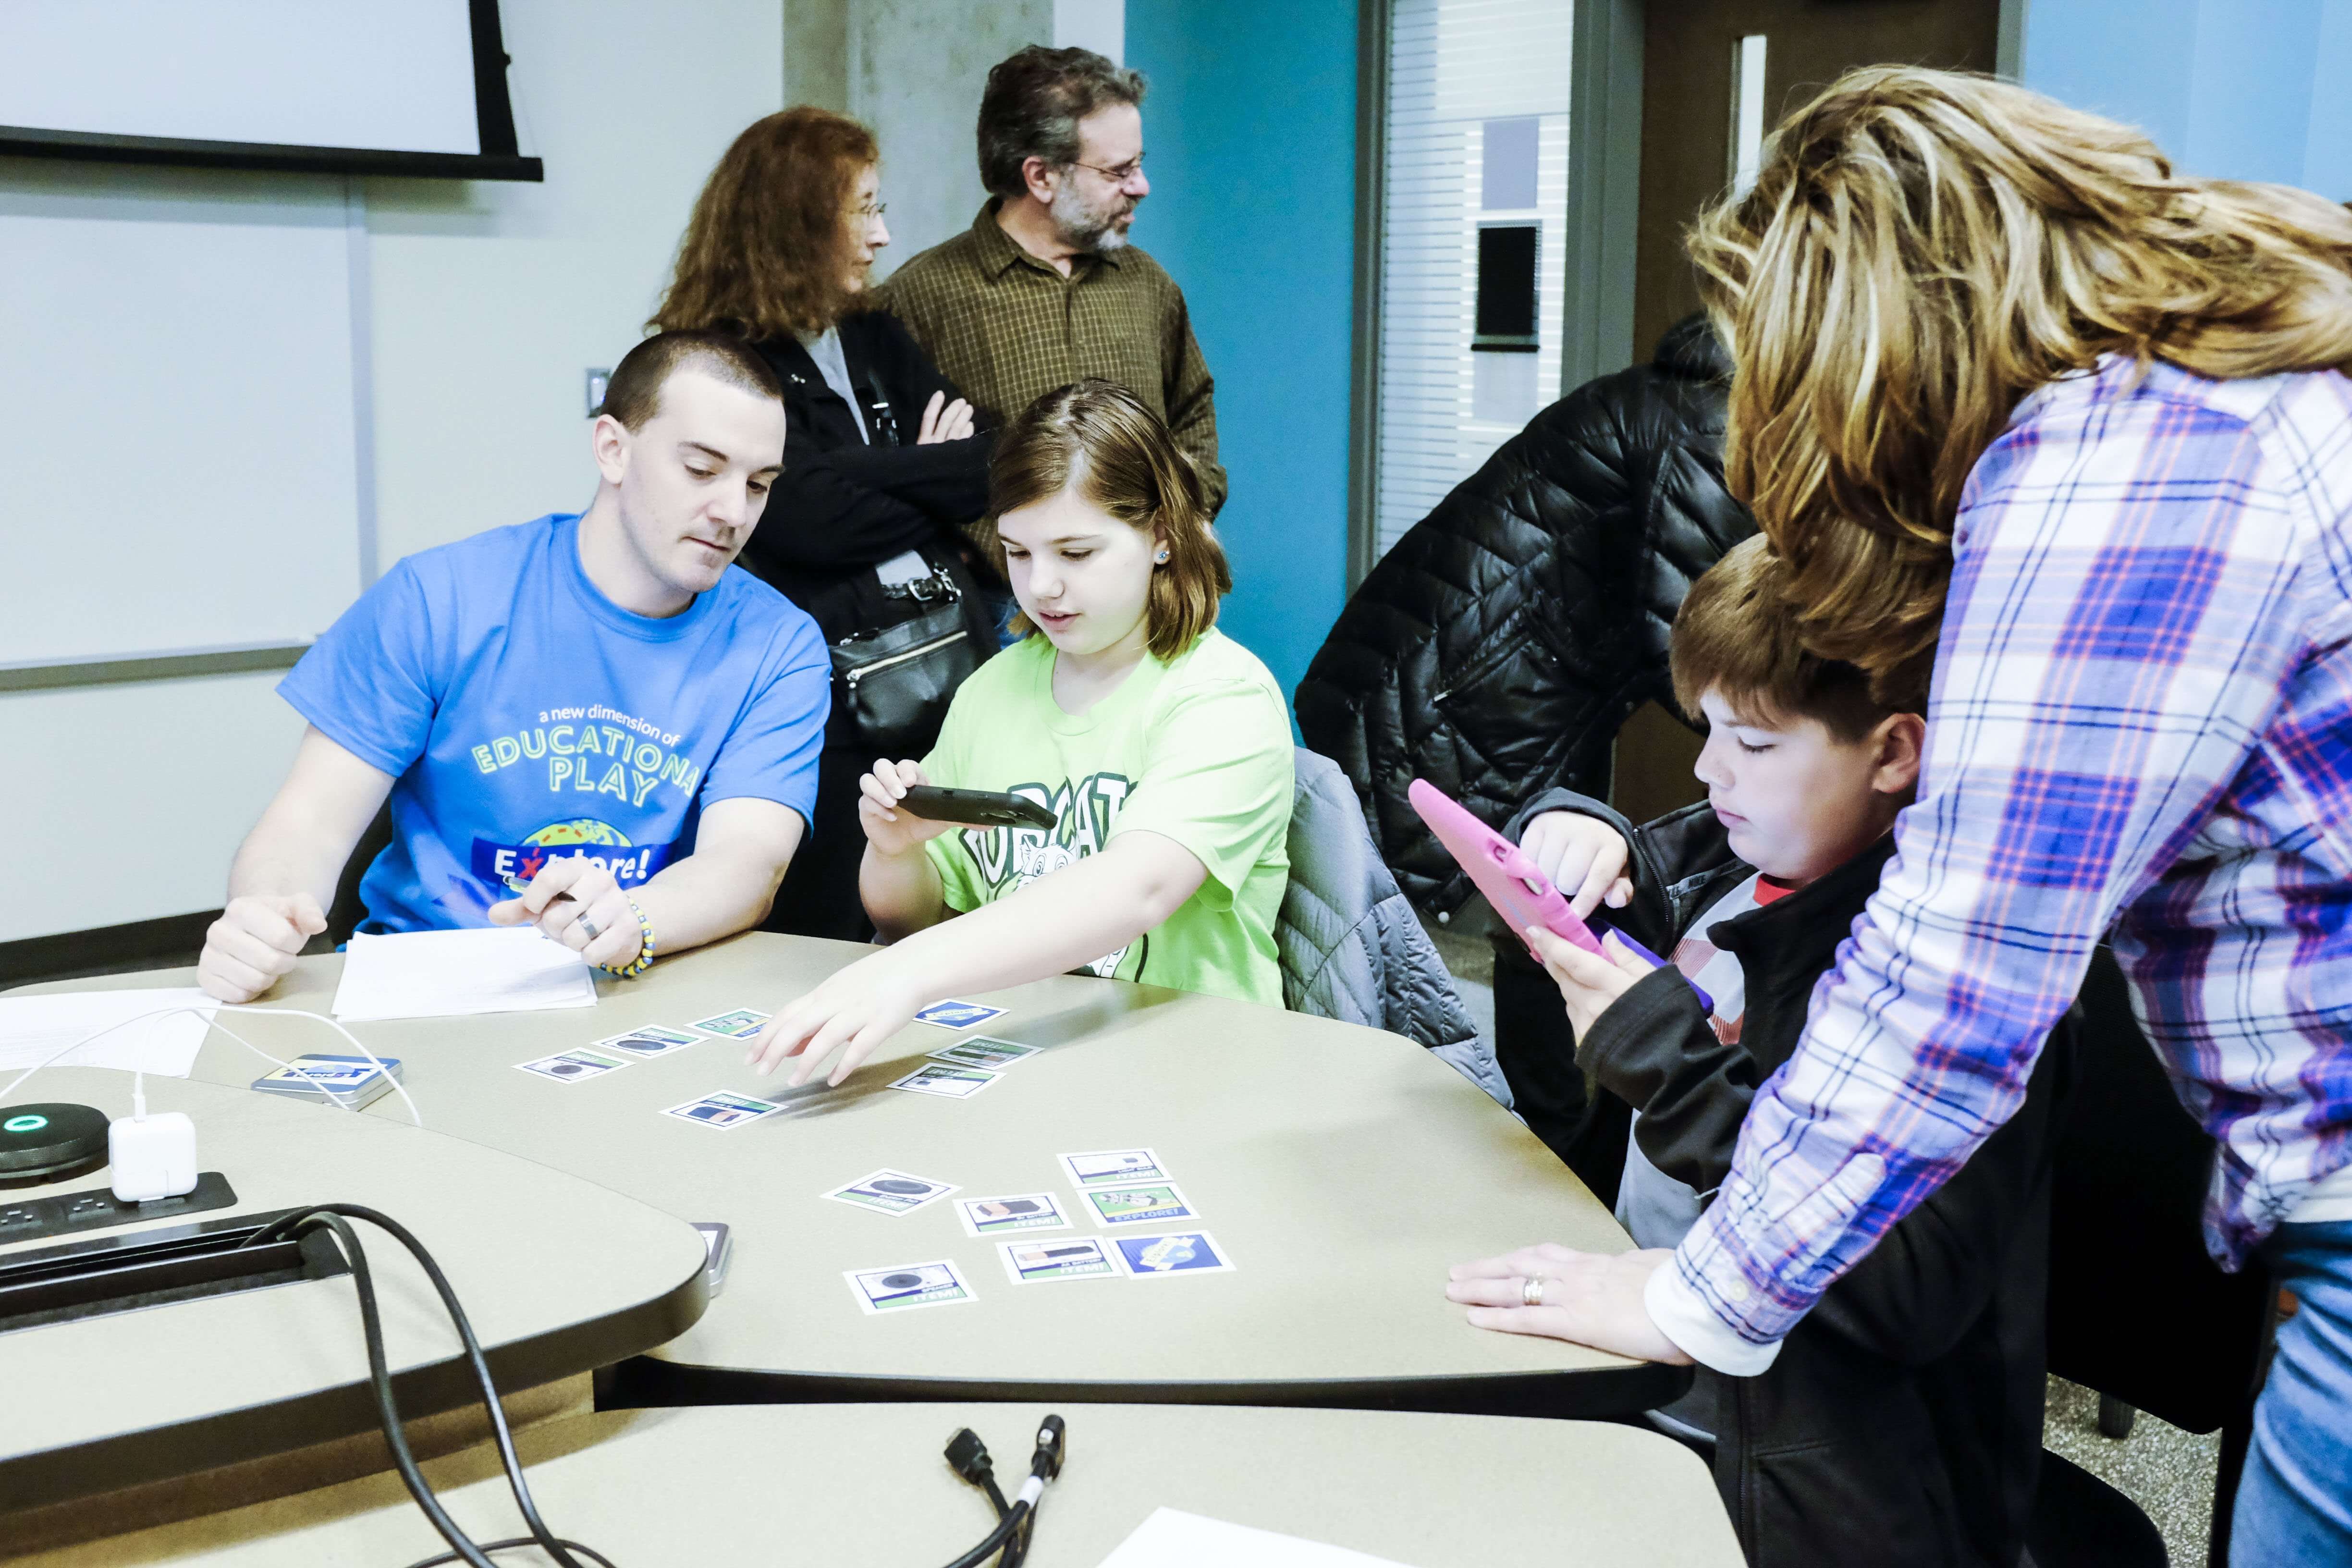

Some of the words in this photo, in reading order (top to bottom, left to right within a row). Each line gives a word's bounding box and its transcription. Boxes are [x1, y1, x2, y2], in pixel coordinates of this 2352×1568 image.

[539, 711, 548, 723] a
[551, 708, 585, 721] new
[588, 705, 660, 738] dimension
[662, 734, 681, 747] of
[471, 725, 700, 797] EDUCATIONA
[550, 757, 658, 808] PLAY
[1115, 1208, 1178, 1222] EXPLORE!
[1014, 1218, 1056, 1228] ITEM!
[1060, 1264, 1104, 1274] ITEM!
[913, 1289, 958, 1302] ITEM!
